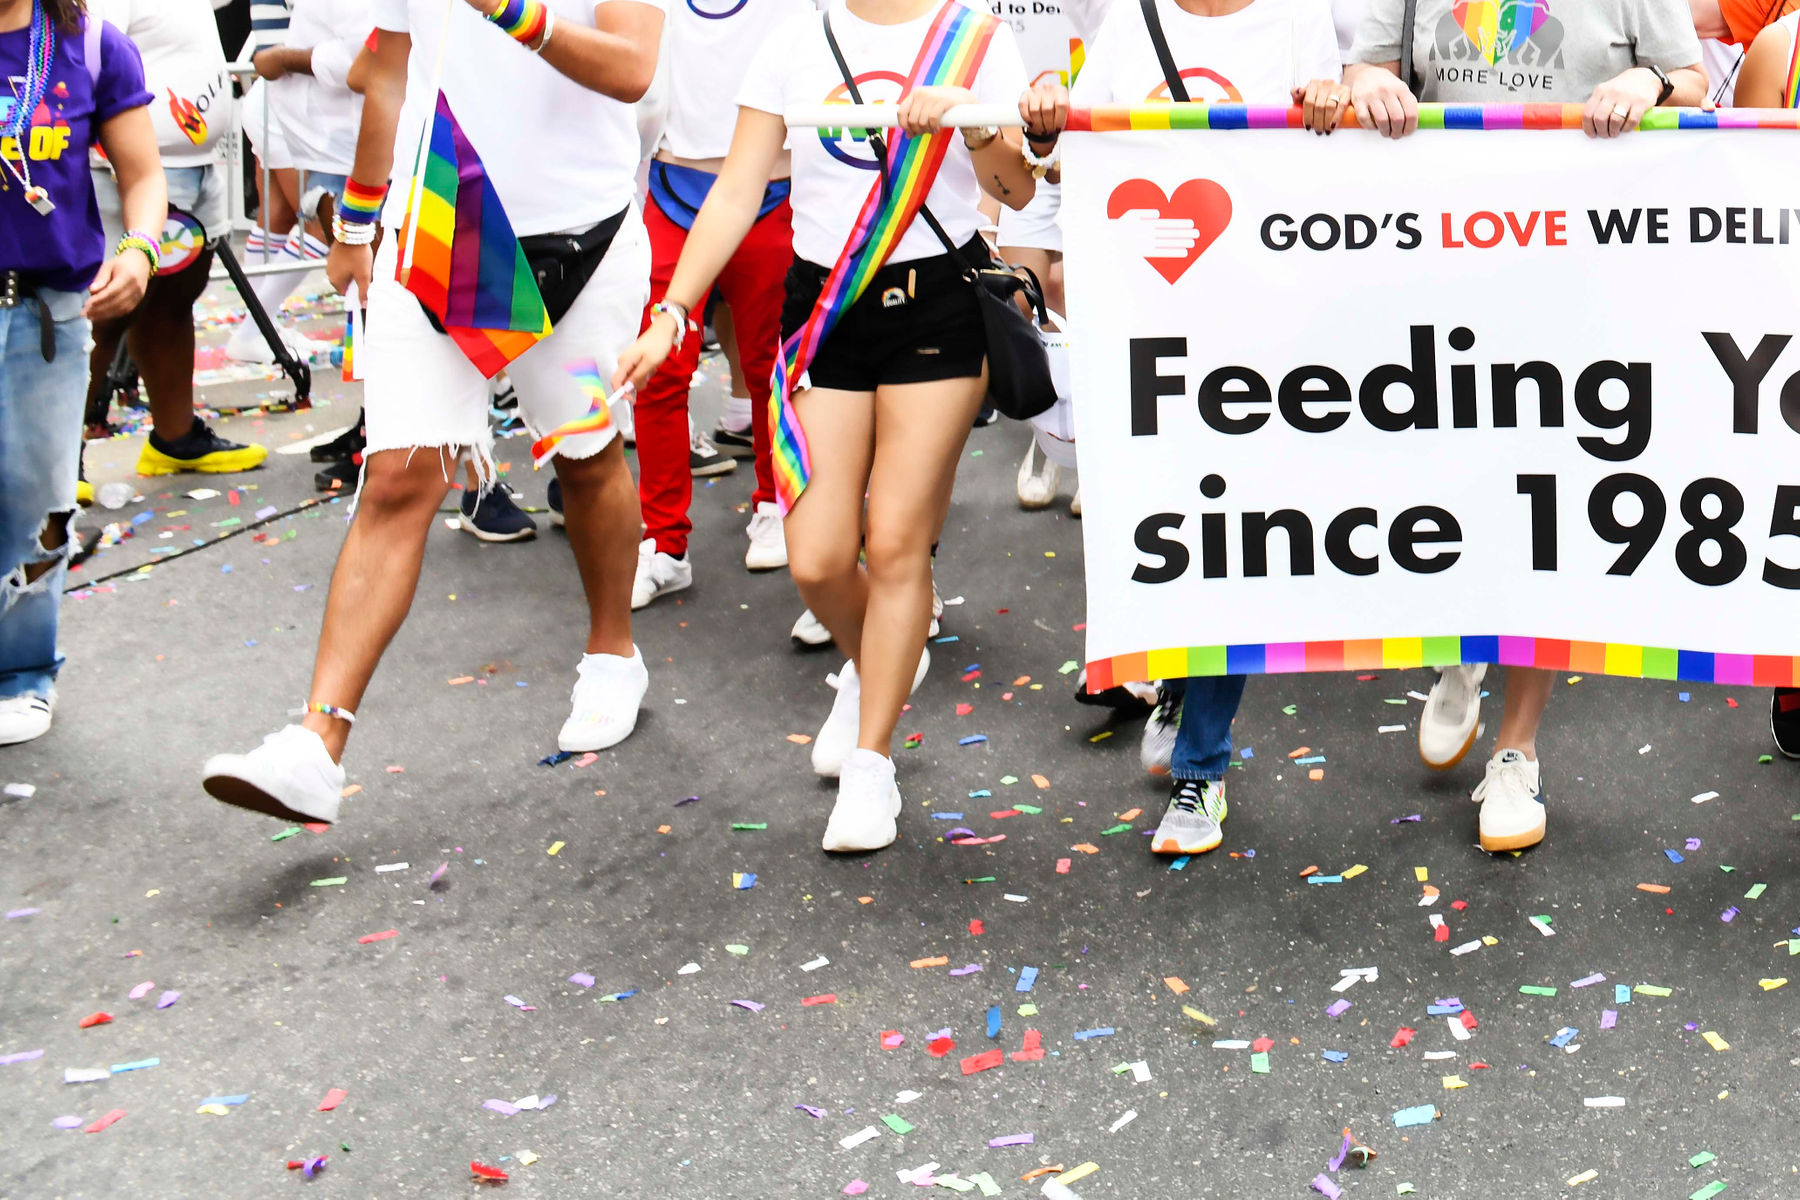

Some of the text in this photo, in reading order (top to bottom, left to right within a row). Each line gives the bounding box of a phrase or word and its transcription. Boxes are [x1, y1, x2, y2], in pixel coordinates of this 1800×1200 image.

[1009, 4, 1025, 14] to
[1435, 68, 1553, 90] MORE LOVE
[29, 126, 71, 160] OF
[1260, 212, 1422, 252] GOD'S
[1440, 210, 1567, 248] LOVE
[1586, 208, 1669, 245] WE
[1129, 325, 1652, 462] Feeding
[1131, 474, 1463, 585] since
